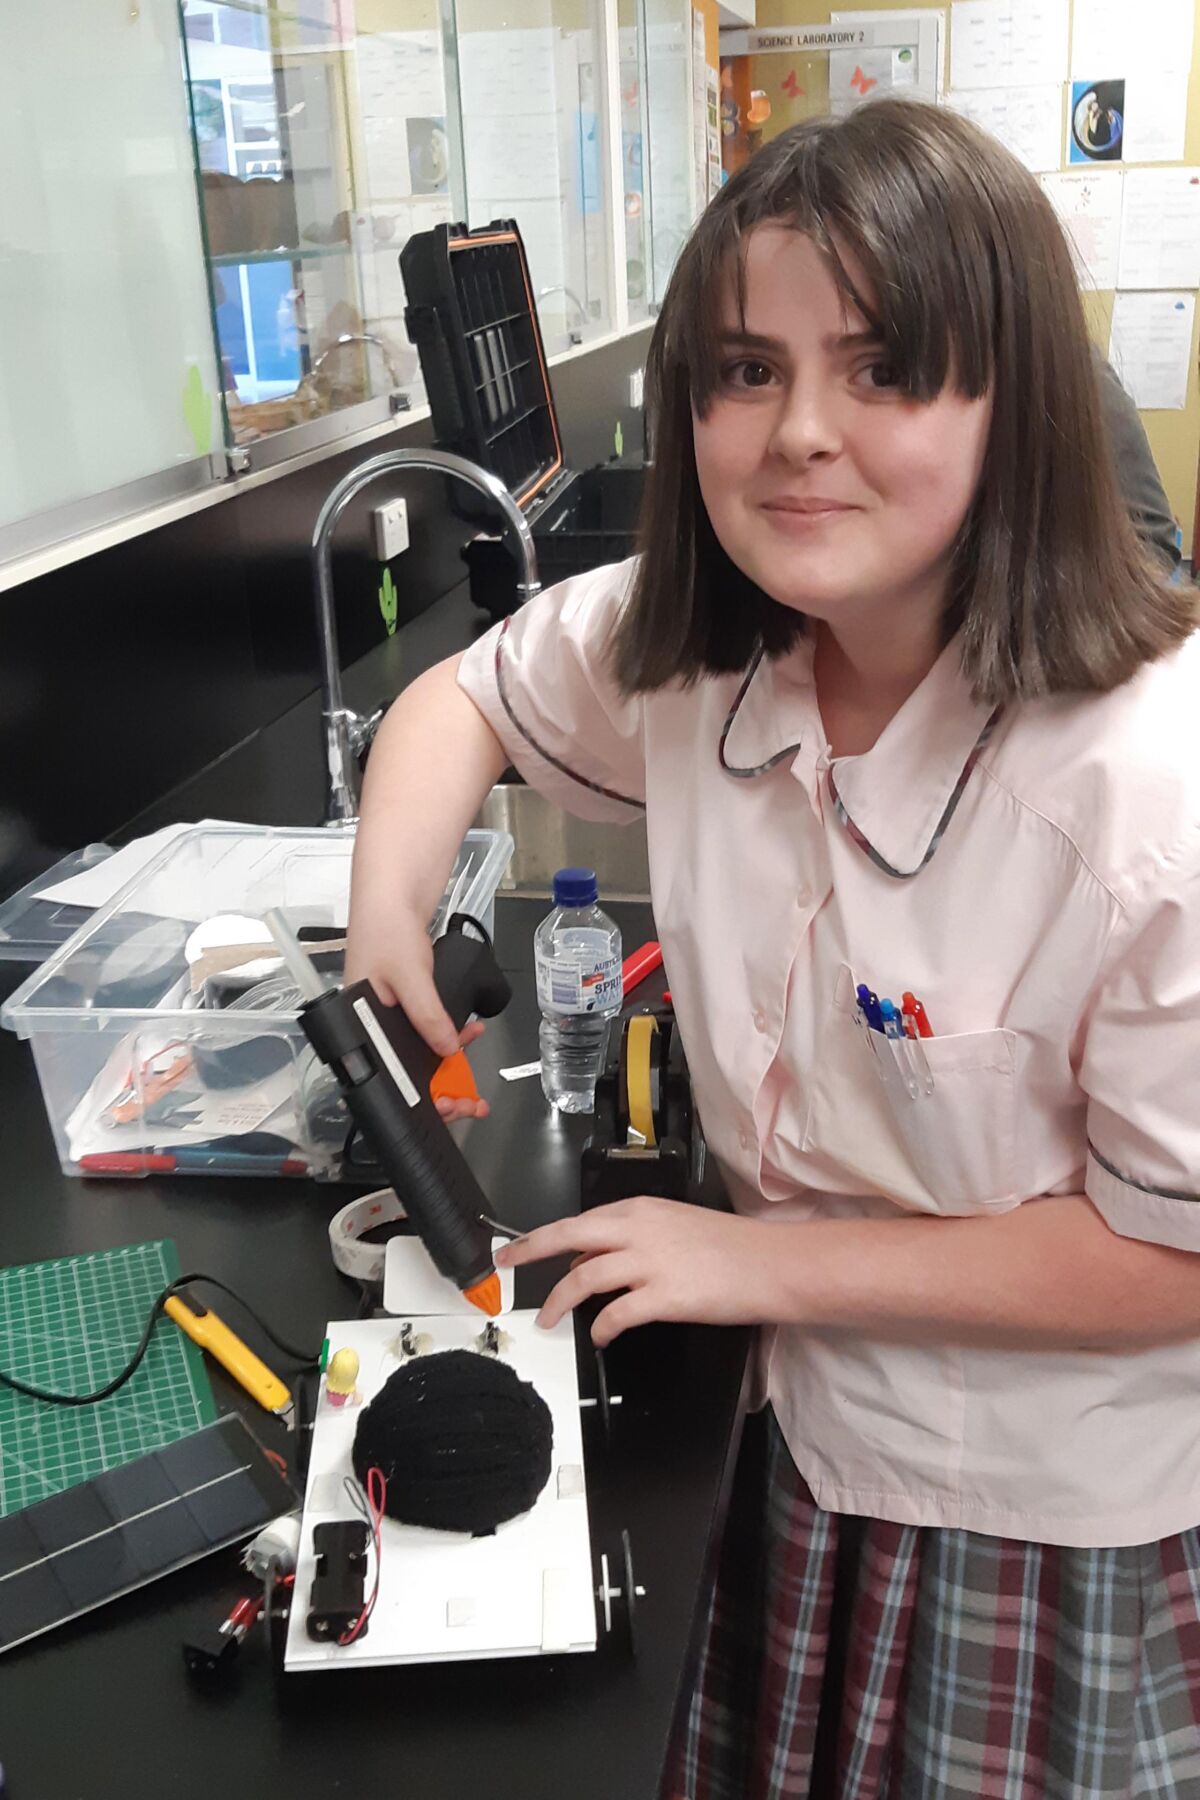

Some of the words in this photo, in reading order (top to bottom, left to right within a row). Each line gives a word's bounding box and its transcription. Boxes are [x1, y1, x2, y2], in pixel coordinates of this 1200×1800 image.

[757, 36, 793, 49] SCIENCE
[797, 32, 855, 45] LABORATORY
[858, 31, 865, 43] 2
